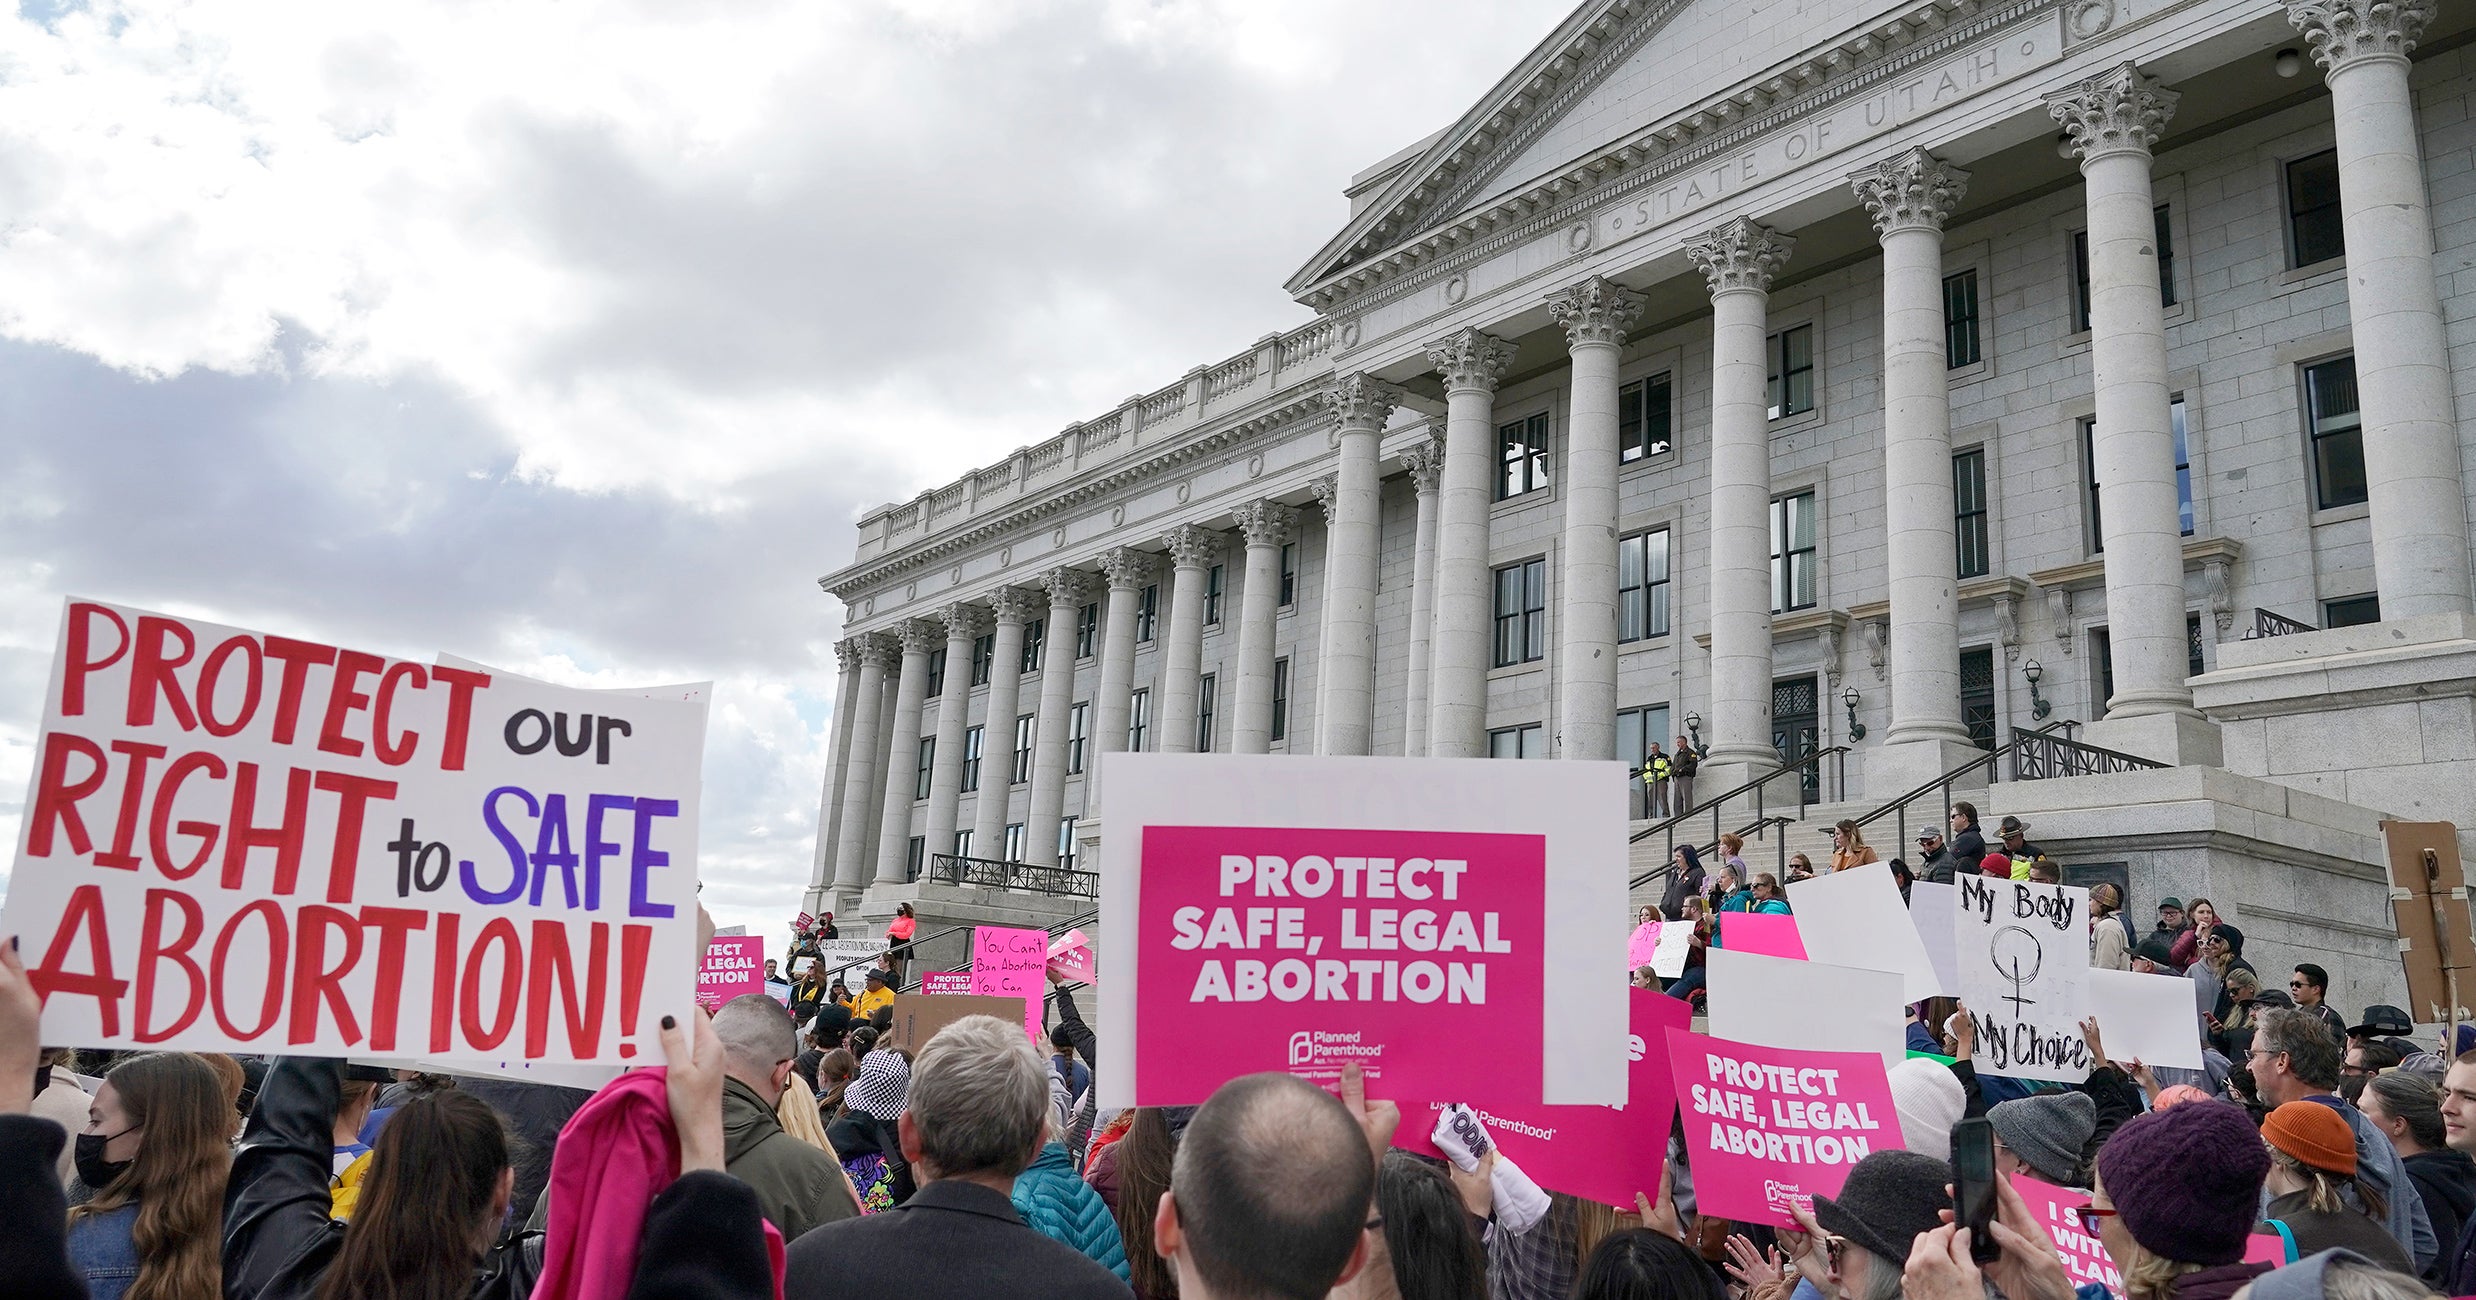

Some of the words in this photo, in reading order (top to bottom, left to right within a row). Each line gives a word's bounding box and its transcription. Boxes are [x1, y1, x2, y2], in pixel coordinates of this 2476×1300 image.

[1634, 152, 1760, 228] STATE
[1784, 118, 1835, 163] OF
[1864, 46, 1999, 128] UTAH
[62, 603, 491, 770] PROTECT
[504, 708, 632, 765] our
[27, 733, 398, 904] RIGHT
[388, 819, 450, 897] to
[459, 786, 678, 918] SAFE
[1219, 855, 1468, 900] PROTECT
[1961, 874, 1996, 926] My
[2010, 884, 2074, 931] Body
[981, 931, 1005, 953] You
[1008, 935, 1042, 954] Can't
[1170, 906, 1324, 956] SAFE,
[1341, 908, 1511, 954] LEGAL
[706, 943, 742, 956] TECT
[706, 957, 756, 970] LEGAL
[976, 957, 997, 973] Ban
[1001, 957, 1043, 971] Abortion
[1065, 958, 1082, 970] All
[25, 885, 652, 1060] ABORTION!
[698, 971, 749, 984] RTION
[926, 982, 950, 991] SAFE,
[951, 982, 971, 990] LEGA
[933, 975, 971, 983] PROTECT
[977, 976, 995, 993] You
[1001, 978, 1022, 992] Can
[1189, 958, 1486, 1005] ABORTION
[1314, 1031, 1360, 1043] Planned
[1314, 1044, 1381, 1057] Parenthood
[1969, 1009, 2008, 1070] My
[2012, 1022, 2088, 1070] Choice
[1706, 1053, 1839, 1096] PROTECT
[1691, 1083, 1767, 1129] SAFE,
[1771, 1099, 1880, 1130] LEGAL
[1710, 1121, 1870, 1165] ABORTION
[2048, 1201, 2058, 1221] I
